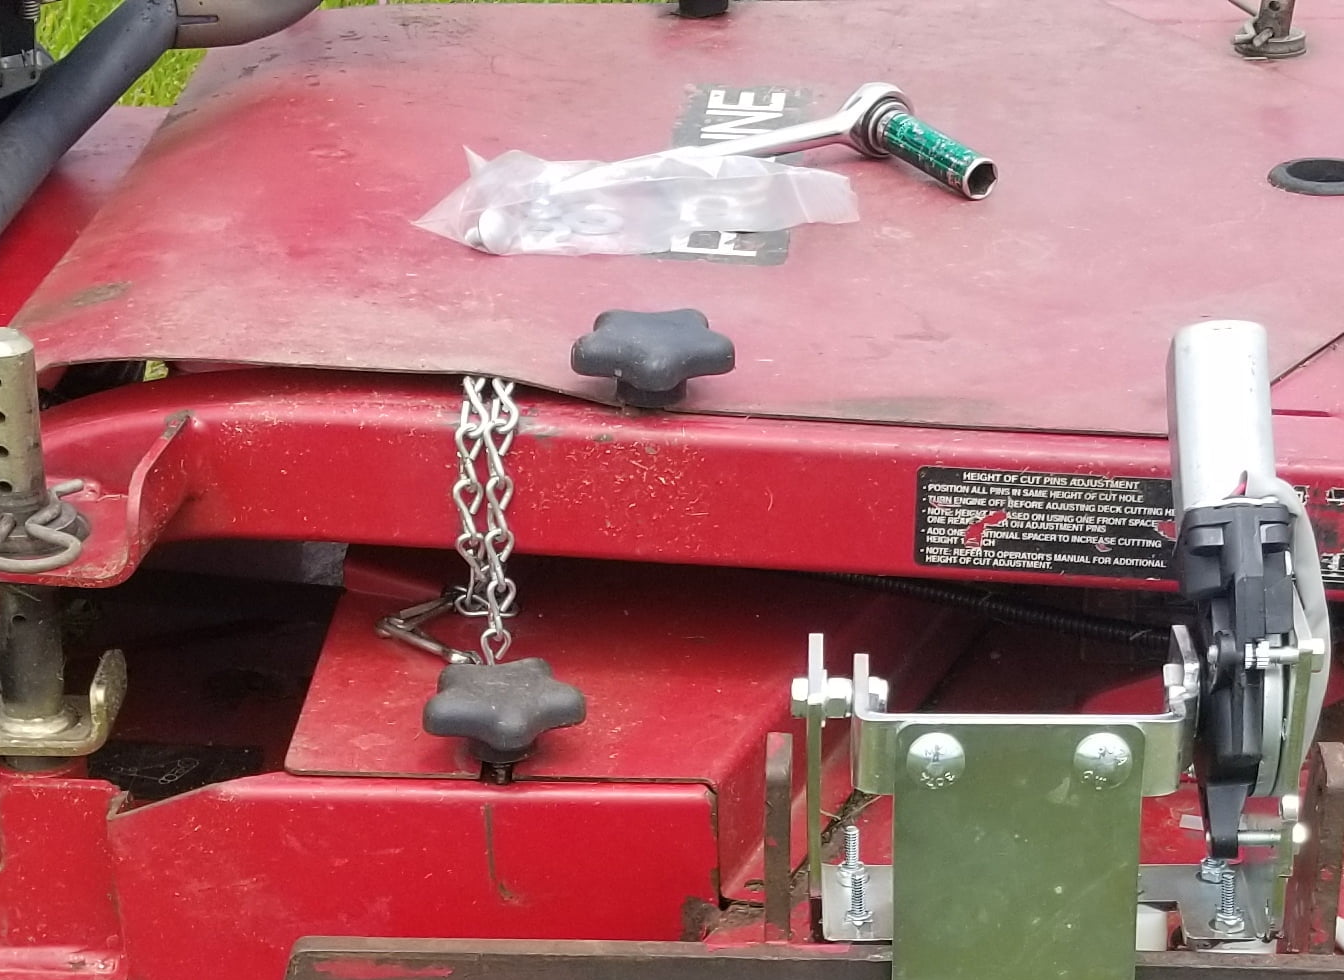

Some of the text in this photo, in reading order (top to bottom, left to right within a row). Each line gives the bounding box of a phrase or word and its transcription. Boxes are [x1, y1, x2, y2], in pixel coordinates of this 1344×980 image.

[963, 472, 1140, 490] HEIGHT OF CUT PINS ADJUSTMENT
[928, 484, 1144, 503] POSITION ALL PINS IN SAME HEIGHT OF CUT HOLE
[928, 495, 952, 505] TURN
[953, 497, 986, 506] ENGINE
[988, 498, 1007, 507] OFF
[1008, 499, 1044, 509] BEFORE
[1045, 502, 1096, 512] ADJUSTING
[1097, 504, 1123, 514] DECK
[1124, 506, 1163, 516] CUTTING
[927, 516, 946, 524] ONE
[1010, 520, 1024, 528] ON
[1025, 521, 1085, 532] ADJUSTMENT
[1086, 524, 1107, 533] PINS
[1006, 511, 1030, 520] ASED
[1031, 512, 1045, 521] ON
[1046, 514, 1075, 523] USING
[1075, 515, 1095, 524] ONE
[1097, 517, 1128, 526] FRONT
[1128, 518, 1159, 528] SPACE
[926, 527, 946, 536] ADD
[947, 528, 966, 537] ONE
[980, 529, 1020, 540] ITIONAL
[1022, 532, 1057, 542] SPACER
[1058, 534, 1070, 543] TO
[1071, 535, 1116, 546] INCREASE
[926, 536, 959, 545] HEIGHT
[925, 547, 1167, 568] NOTE: REFER TO OPERATOR'S MANUAL FOR ADDITIONAL
[926, 555, 1053, 570] HEIGHT OF CUT ADJUSTMENT.
